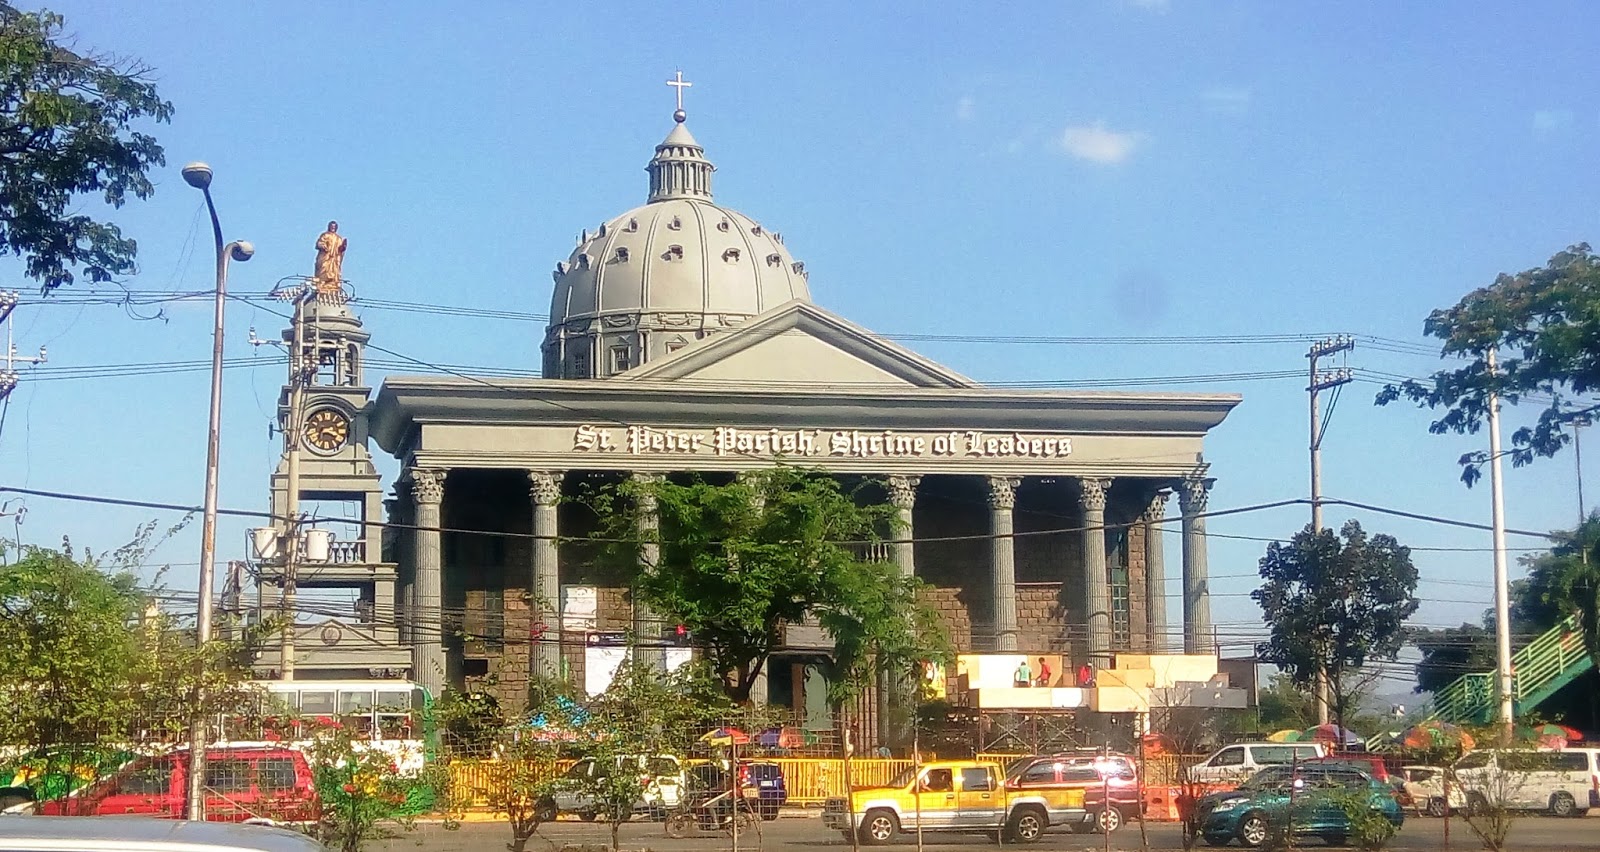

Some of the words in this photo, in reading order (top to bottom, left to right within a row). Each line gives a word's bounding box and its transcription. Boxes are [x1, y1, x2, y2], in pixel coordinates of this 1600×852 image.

[575, 424, 617, 451] St.
[627, 425, 705, 454] Peter
[829, 430, 925, 457] Shrine
[932, 431, 958, 456] of
[964, 431, 1072, 457] Leaders
